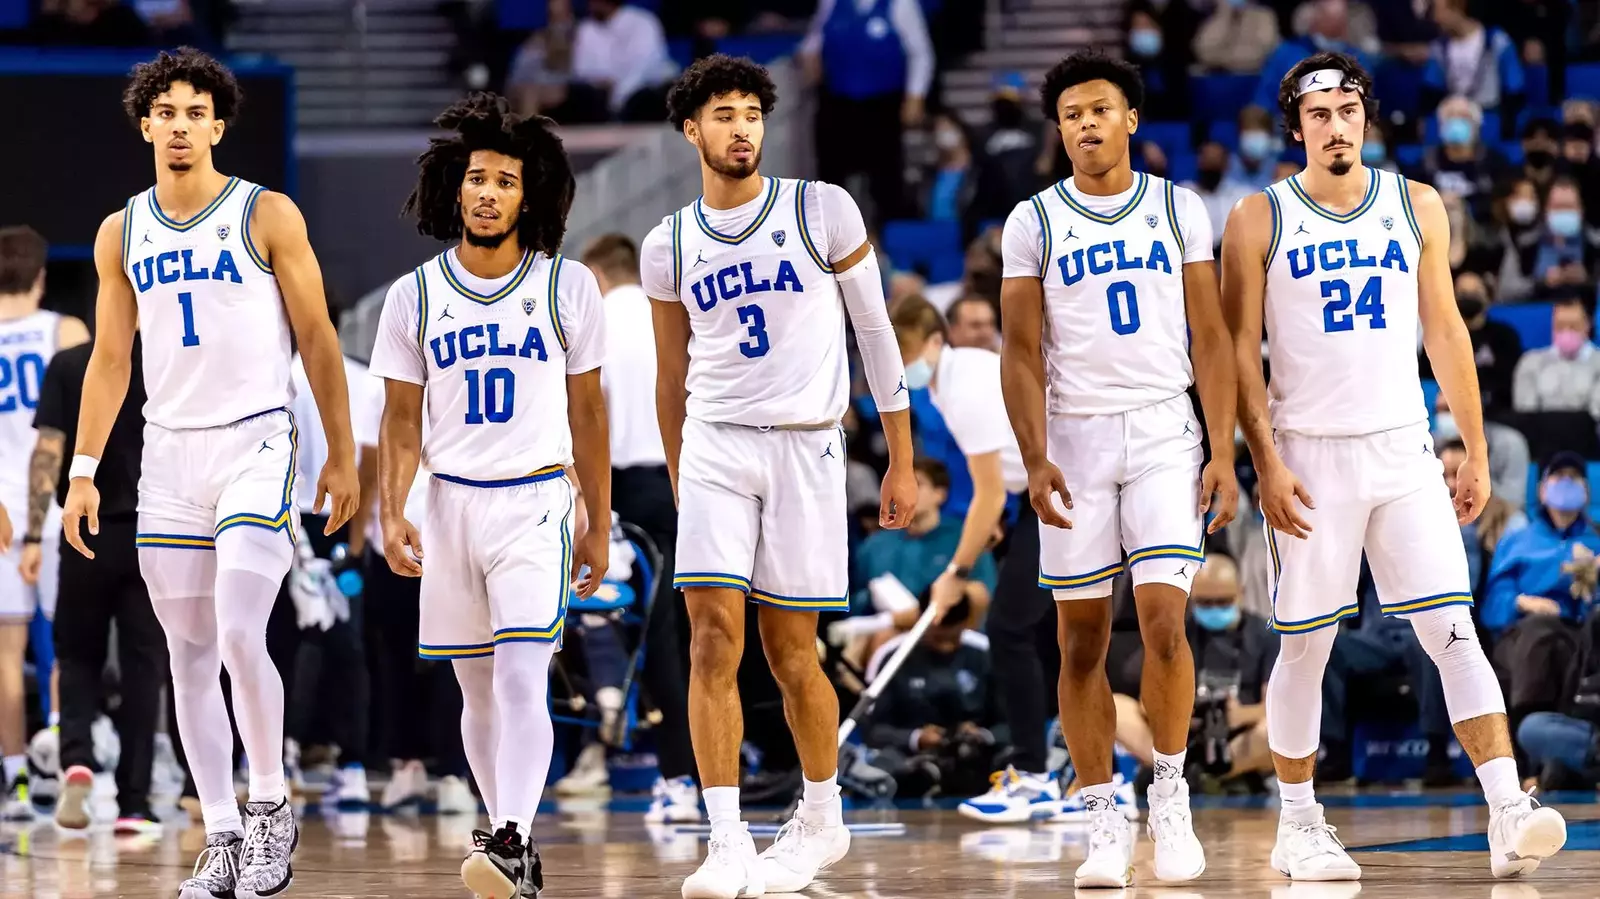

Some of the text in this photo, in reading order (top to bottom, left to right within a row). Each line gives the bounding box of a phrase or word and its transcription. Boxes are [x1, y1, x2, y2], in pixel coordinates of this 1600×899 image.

[132, 249, 243, 292] UCLA
[690, 260, 804, 312] UCLA
[1057, 240, 1172, 287] UCLA
[1286, 239, 1409, 280] UCLA
[177, 292, 200, 347] 1
[736, 303, 770, 359] 3
[1106, 280, 1141, 336] 0
[1319, 275, 1387, 333] 24
[429, 323, 548, 369] UCLA
[0, 353, 47, 413] 20
[464, 367, 515, 425] 10
